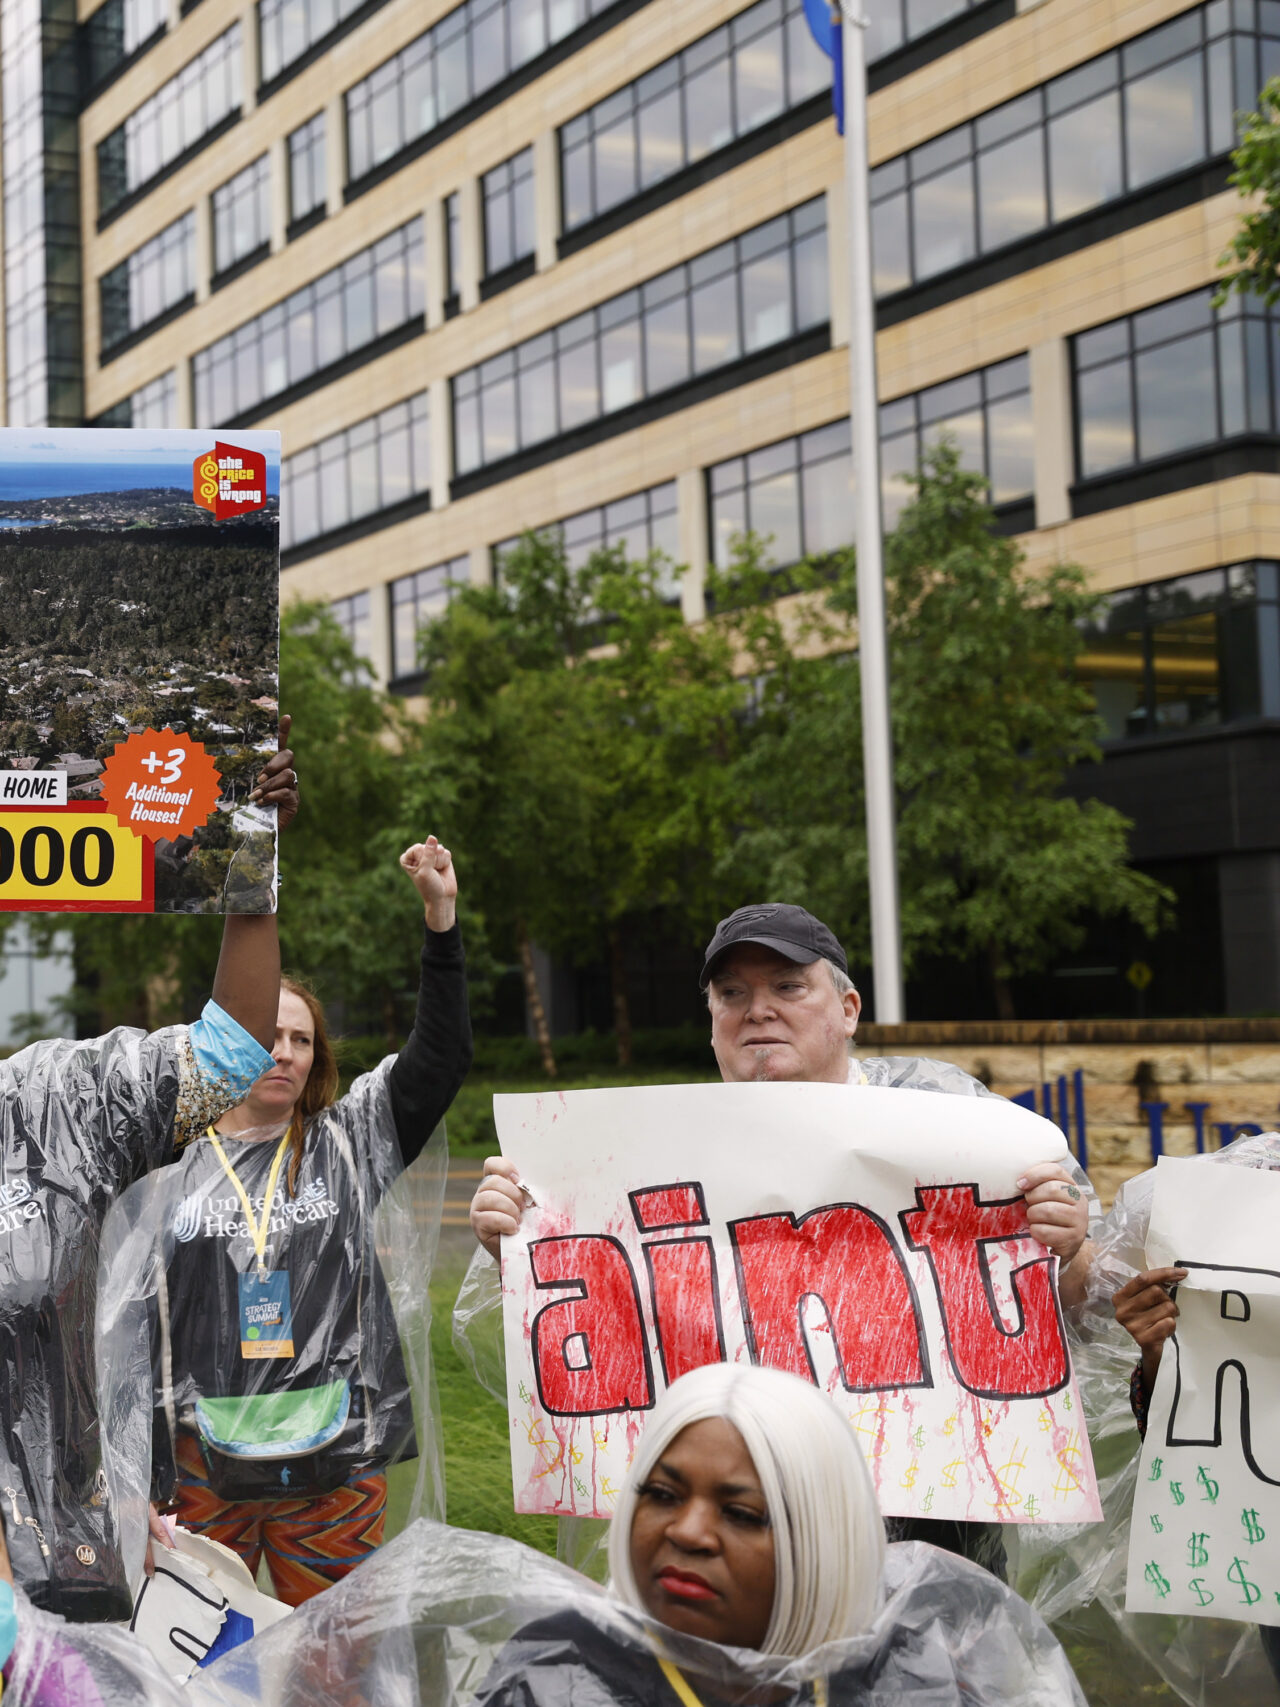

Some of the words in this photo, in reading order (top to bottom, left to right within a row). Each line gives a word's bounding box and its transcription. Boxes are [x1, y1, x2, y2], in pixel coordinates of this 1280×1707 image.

[141, 748, 186, 784] +3
[3, 777, 58, 799] HOME
[125, 782, 193, 805] Additional
[130, 802, 184, 825] Houses!
[245, 1302, 282, 1317] STRATEGY
[528, 1181, 1072, 1418] aint
[248, 1311, 280, 1324] SUMMIT
